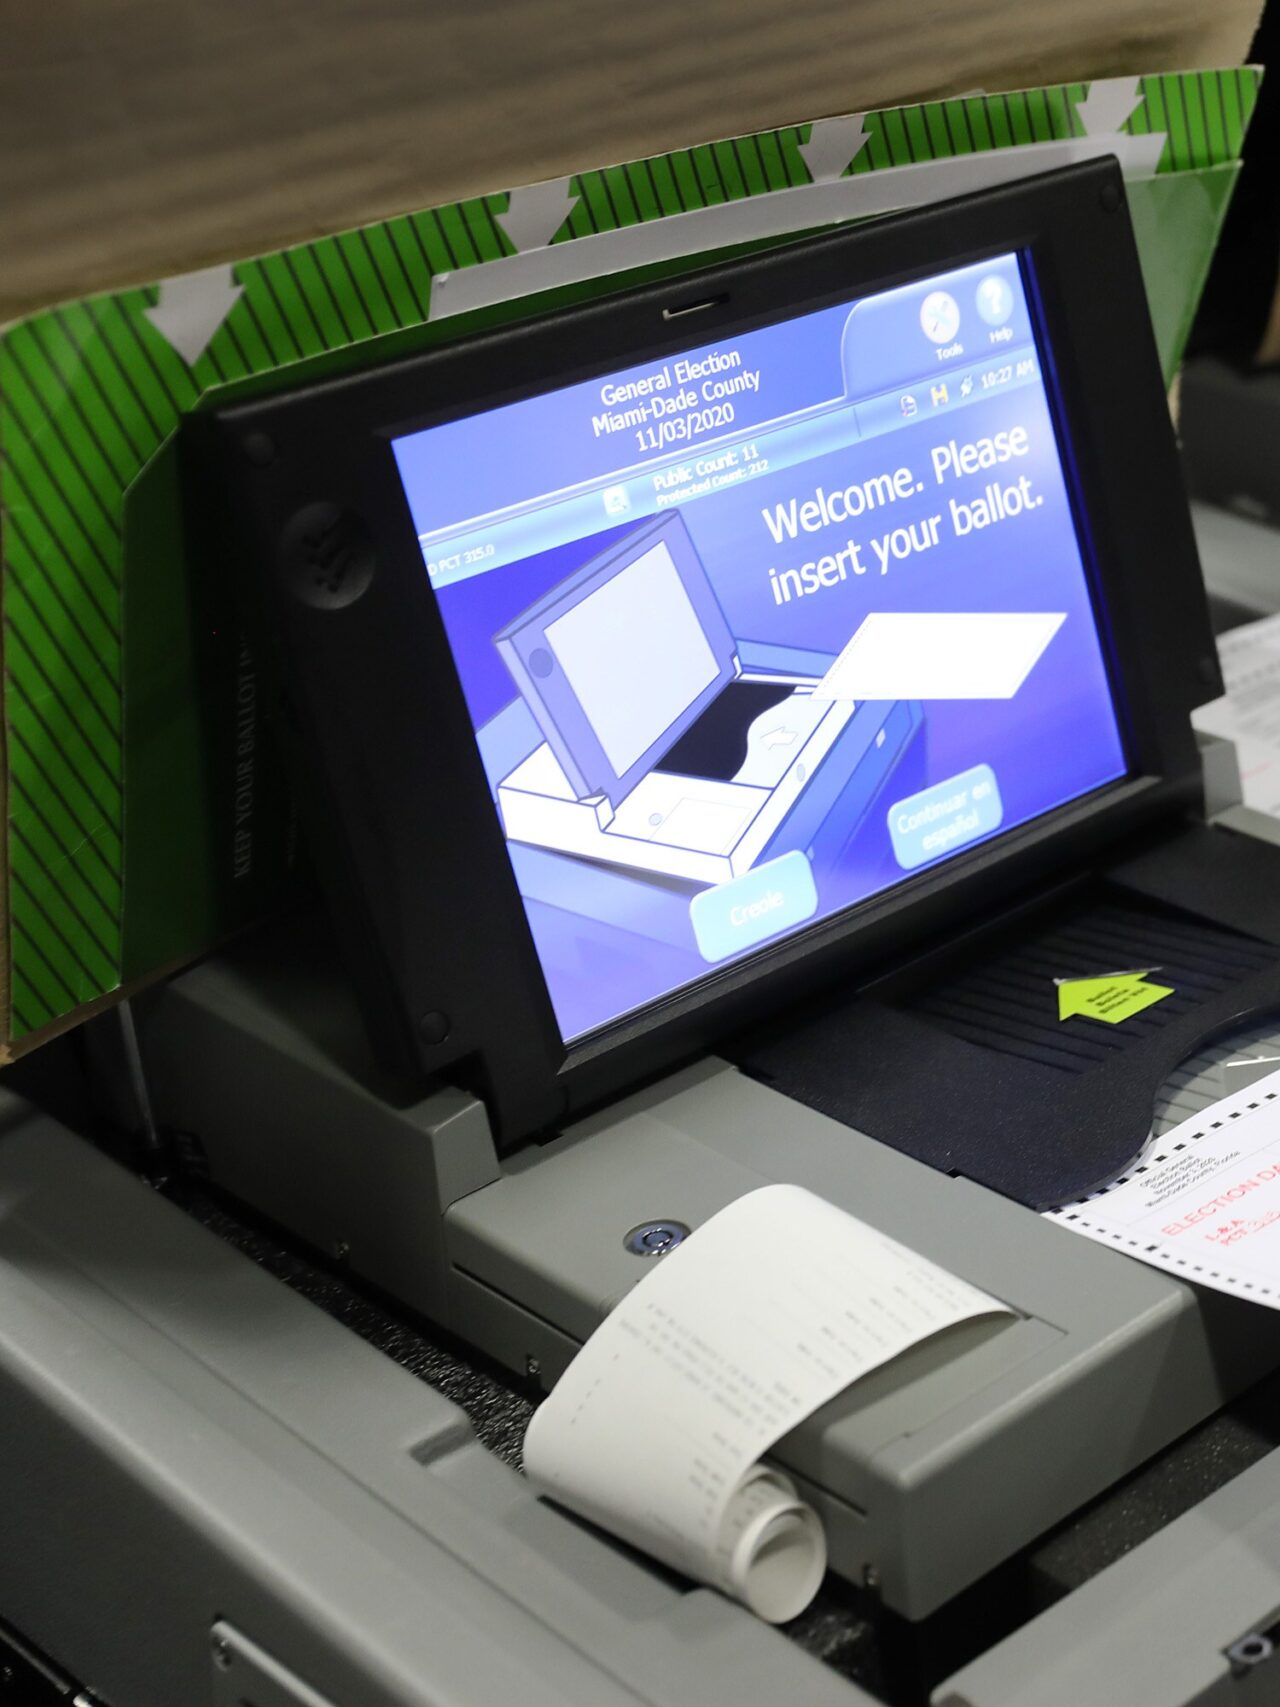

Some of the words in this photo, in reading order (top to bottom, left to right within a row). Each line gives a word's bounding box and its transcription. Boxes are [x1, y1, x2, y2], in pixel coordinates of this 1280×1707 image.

[936, 342, 964, 360] Tools
[989, 327, 1014, 344] Help
[601, 366, 671, 406] General
[674, 350, 742, 385] Election
[981, 365, 1012, 389] 10:27
[1016, 359, 1035, 377] AM
[591, 388, 699, 438] Miami-Dade
[702, 370, 760, 402] County
[636, 402, 735, 452] 11/03/2020
[652, 467, 693, 491] Public
[696, 450, 738, 477] Count:
[742, 443, 760, 462] 11
[656, 478, 712, 507] Protected
[748, 459, 769, 476] 212
[761, 467, 924, 544] Welcome.
[931, 426, 1029, 485] Please
[439, 554, 461, 573] PCT
[768, 540, 866, 605] insert
[870, 514, 941, 576] your
[949, 475, 1044, 537] ballot.
[898, 788, 968, 834] Continuar
[972, 780, 991, 800] en
[922, 808, 980, 851] español
[729, 889, 784, 927] Creole
[1161, 1178, 1261, 1237] ELECTION
